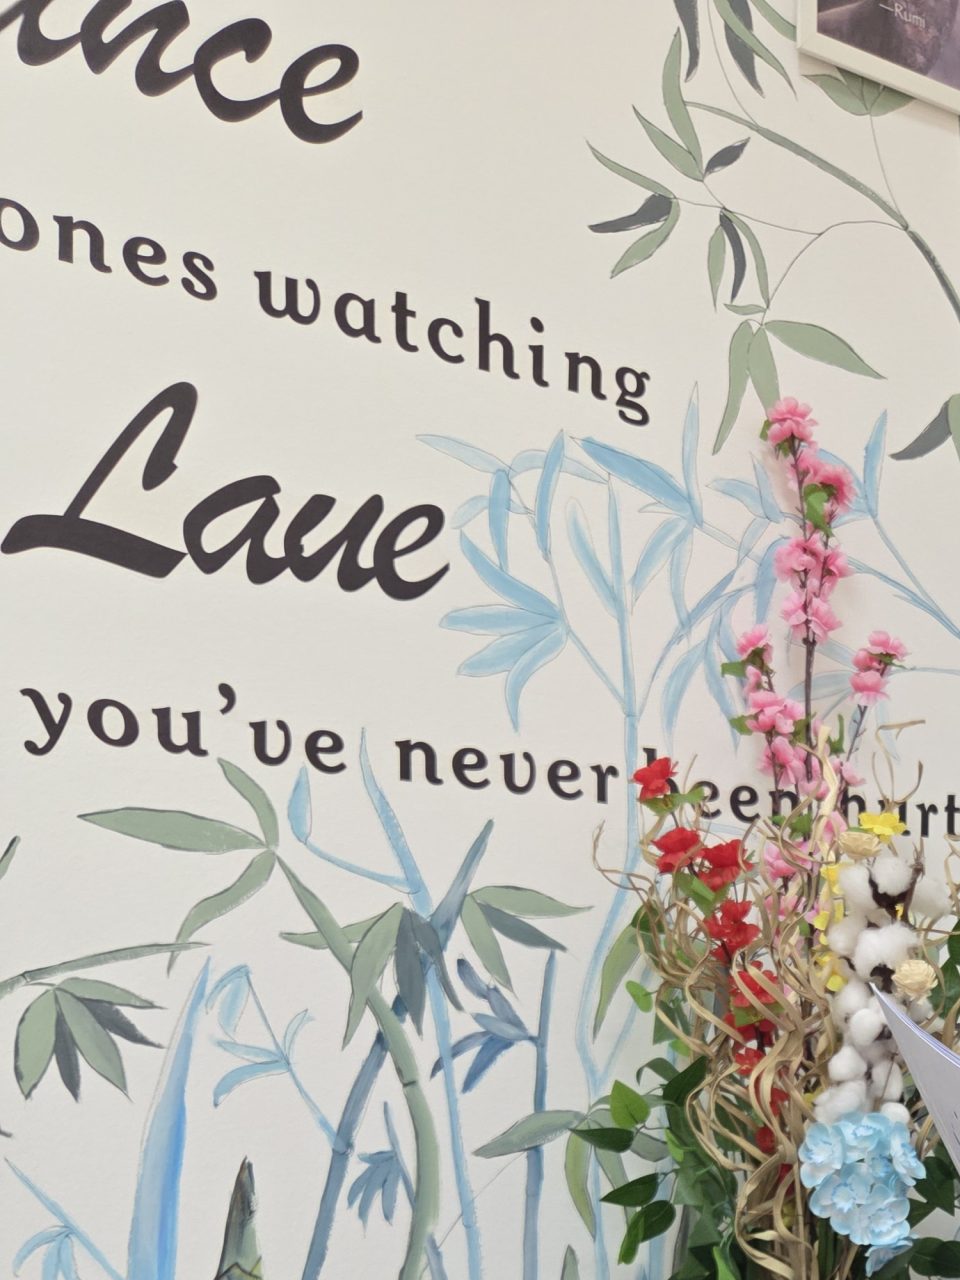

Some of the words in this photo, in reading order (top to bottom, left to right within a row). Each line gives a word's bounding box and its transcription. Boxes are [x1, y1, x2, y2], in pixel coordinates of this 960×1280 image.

[0, 198, 218, 301] ones
[254, 272, 650, 426] watching
[395, 740, 619, 803] never
